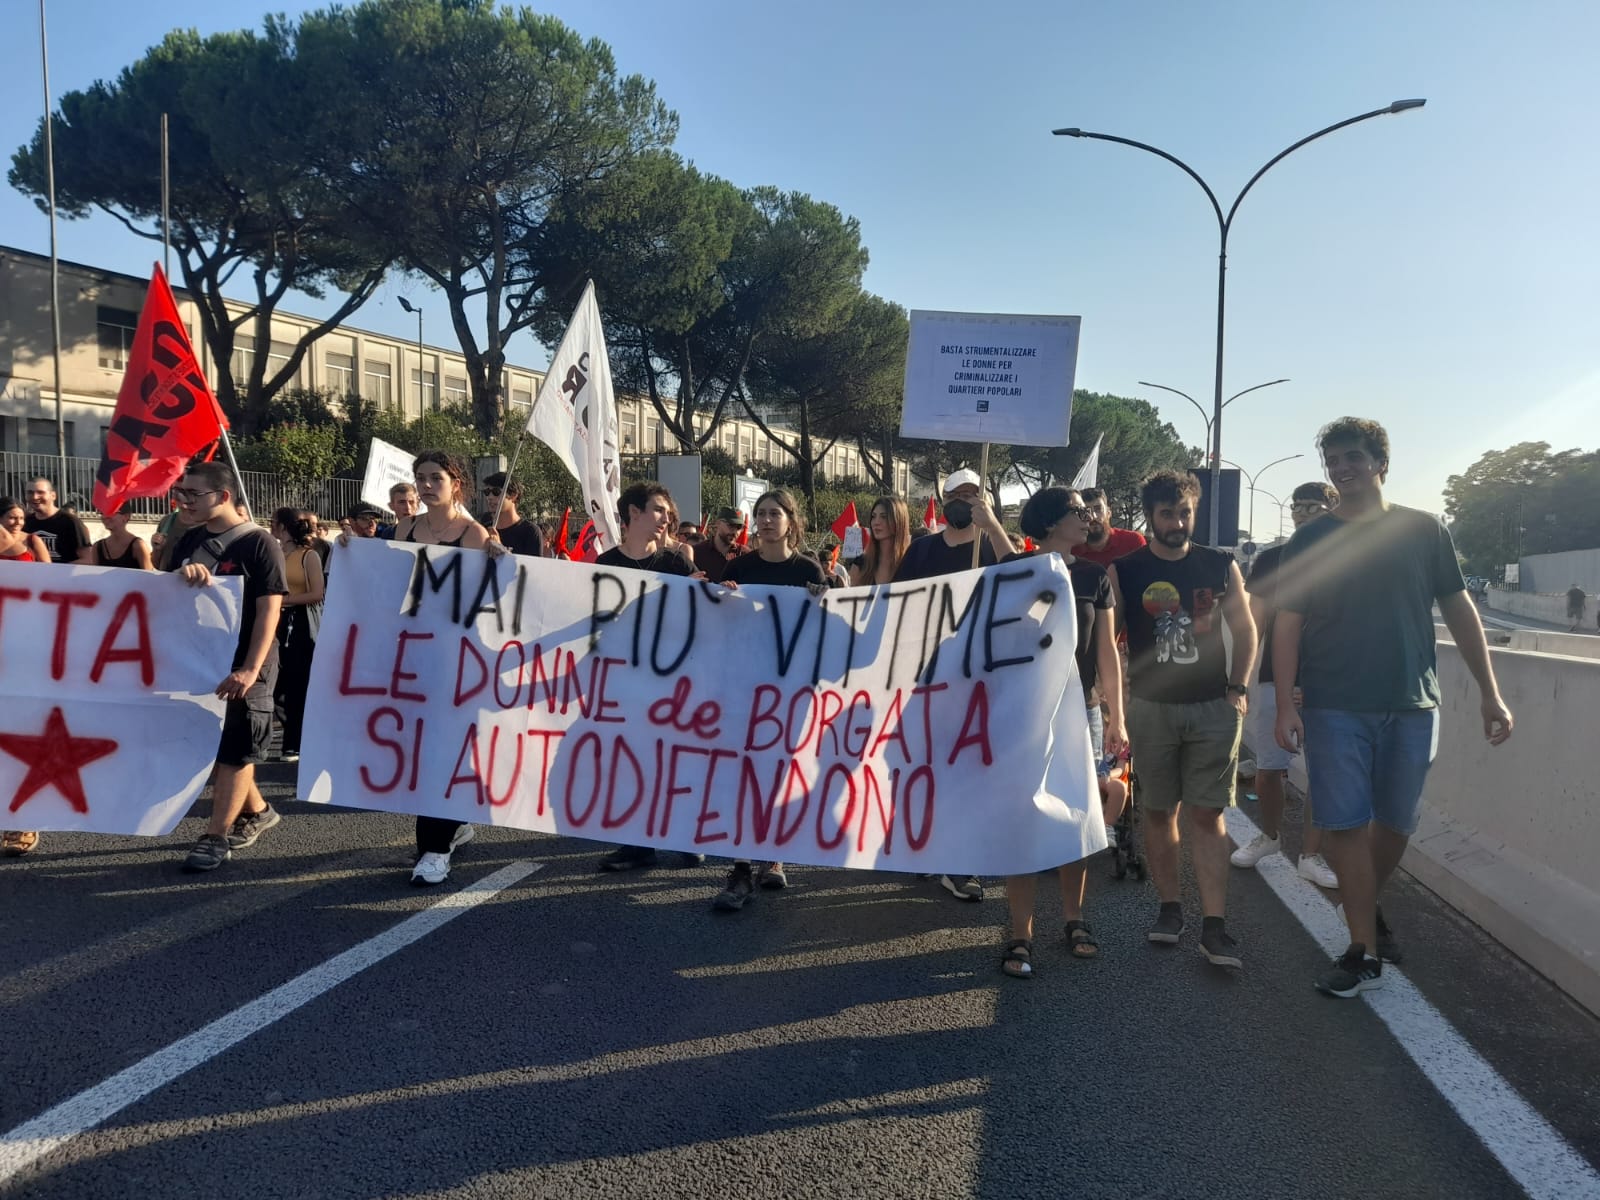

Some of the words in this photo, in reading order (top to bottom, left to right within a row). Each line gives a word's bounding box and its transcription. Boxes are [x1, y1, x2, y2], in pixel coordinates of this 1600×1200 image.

[940, 345, 963, 355] BASTA
[965, 346, 1037, 358] STRUMENTALIZZARE
[962, 359, 971, 368] LE
[972, 360, 997, 369] DONNE
[998, 360, 1012, 370] PER
[954, 371, 1013, 383] CRIMINALIZZARE
[948, 384, 985, 395] QUARTIERI
[986, 386, 1022, 397] POPOLARI
[409, 546, 527, 636] MAI
[768, 569, 1057, 690] VITTIME:
[339, 623, 434, 702] LE
[453, 636, 627, 722] DONNE
[648, 676, 721, 739] de
[743, 681, 992, 766] BORGATA
[359, 707, 424, 793] SI
[444, 722, 935, 855] AUTODIFENDONO
